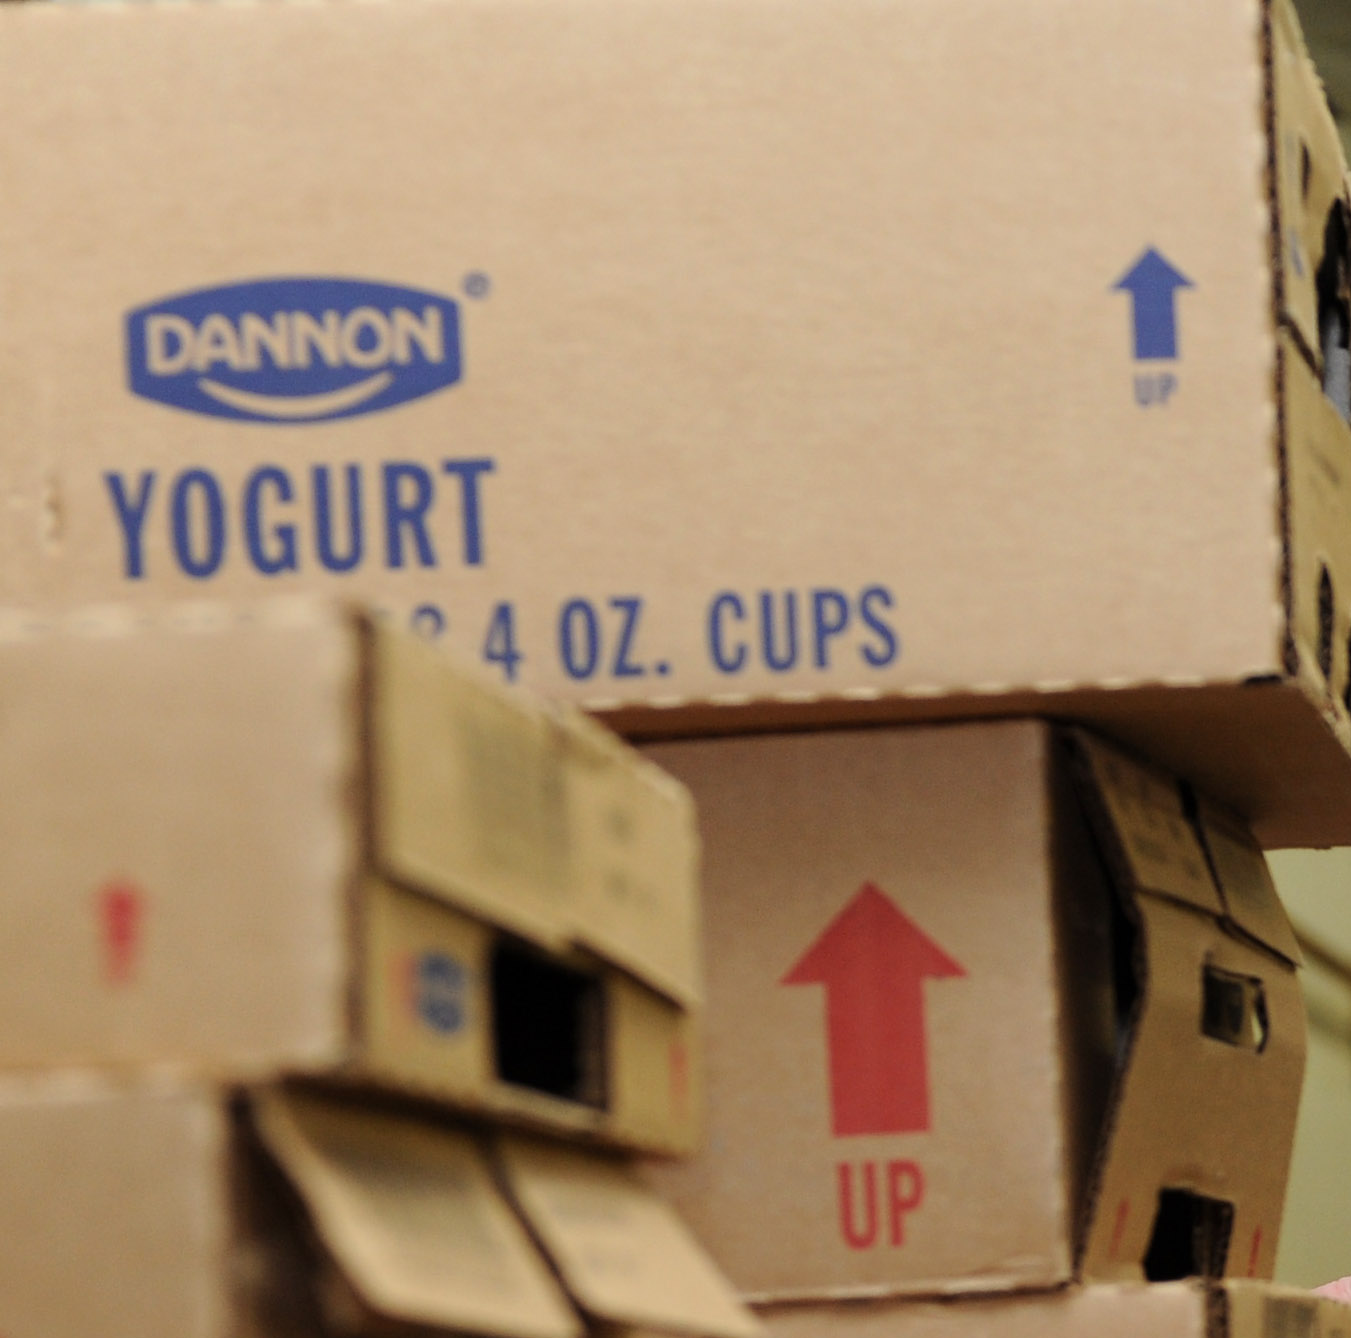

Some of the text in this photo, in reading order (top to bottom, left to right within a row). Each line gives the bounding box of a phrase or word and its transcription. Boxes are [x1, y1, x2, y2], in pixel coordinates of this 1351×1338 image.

[143, 304, 447, 377] DANNON
[1133, 373, 1179, 407] UP
[104, 458, 496, 580] YOGURT
[483, 600, 523, 684] 4
[558, 595, 669, 681] OZ.
[706, 584, 901, 674] CUPS
[835, 1159, 926, 1250] UP
